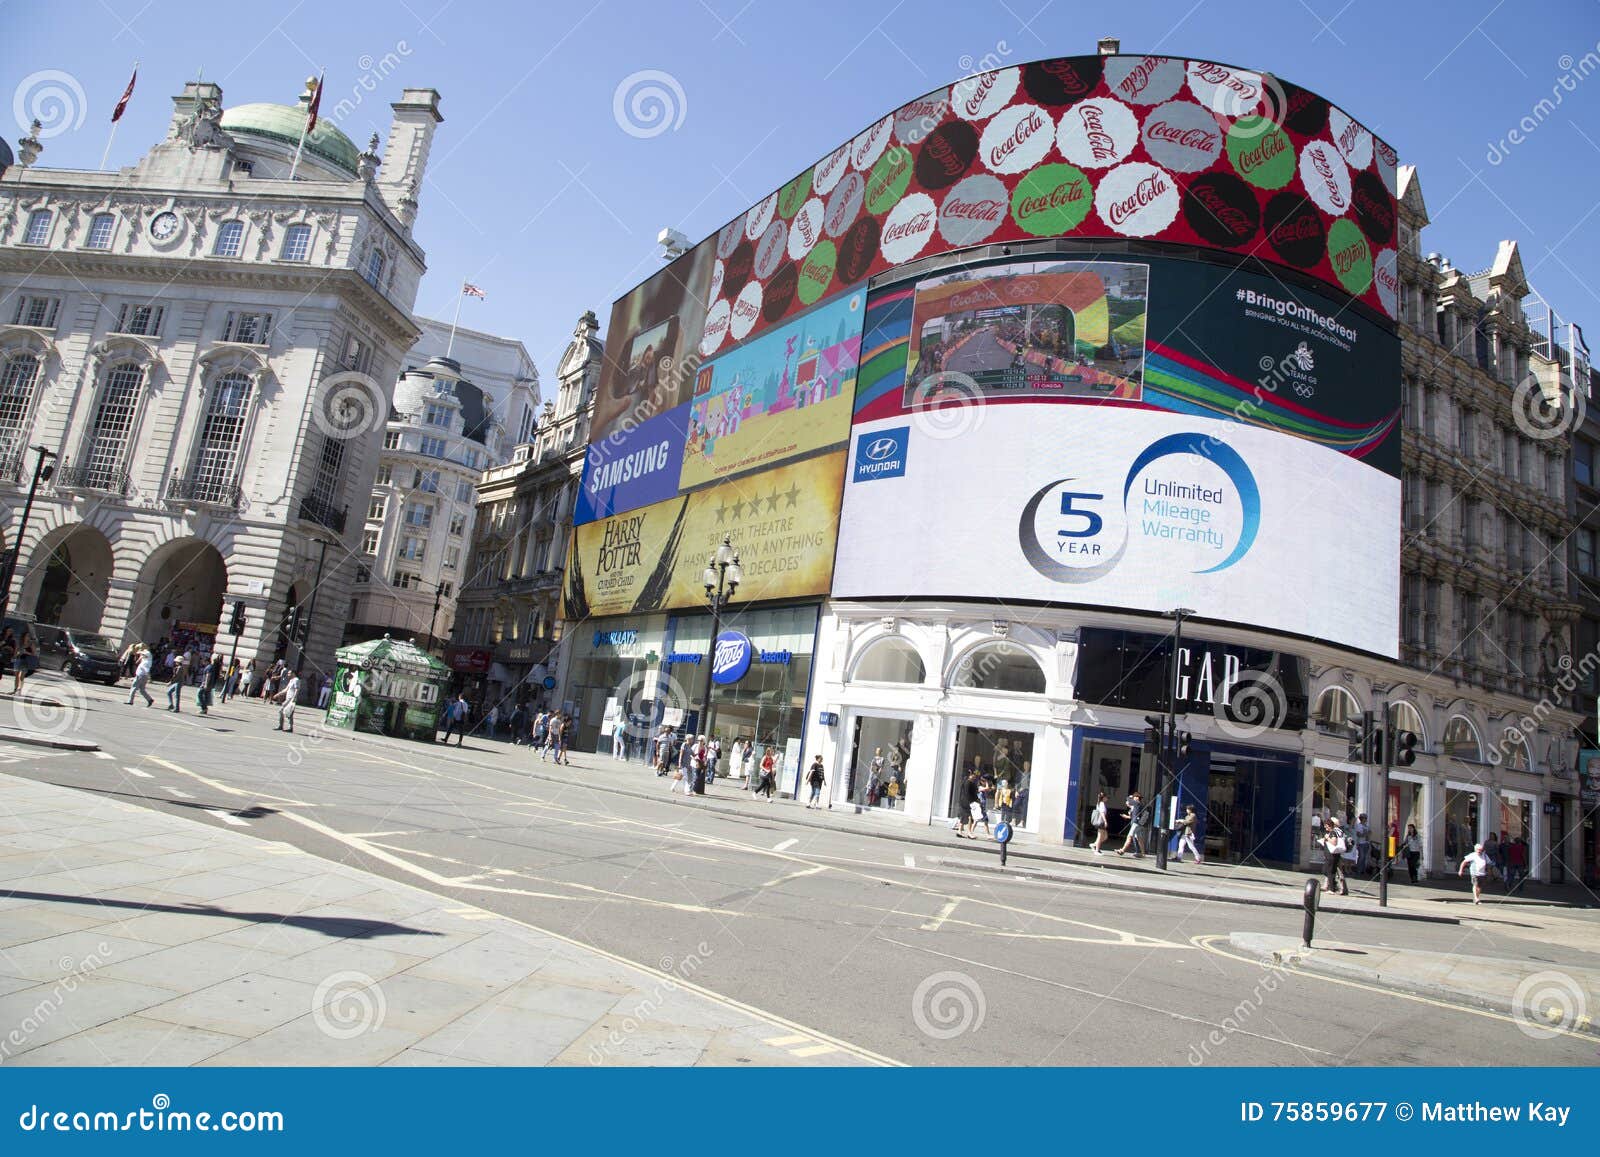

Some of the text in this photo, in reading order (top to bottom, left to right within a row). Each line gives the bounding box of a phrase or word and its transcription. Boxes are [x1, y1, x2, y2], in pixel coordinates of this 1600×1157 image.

[1236, 288, 1358, 343] #BringOnTheGreat
[1245, 309, 1277, 323] BRINGING
[1277, 316, 1290, 328] YOU
[1290, 370, 1308, 382] TEAM
[591, 440, 669, 494] SAMSUNG
[859, 460, 900, 474] HYUNDAI
[1144, 478, 1223, 504] Unlimited
[1058, 492, 1104, 538] 5
[1143, 499, 1211, 525] Mileage
[603, 513, 646, 547] HARRY
[749, 517, 795, 538] THEATRE
[1143, 520, 1224, 550] Warranty
[762, 531, 824, 553] ANYTHING
[1057, 541, 1101, 556] YEAR
[596, 541, 642, 576] POTTER
[760, 649, 792, 665] beauty
[1175, 647, 1240, 706] GAP
